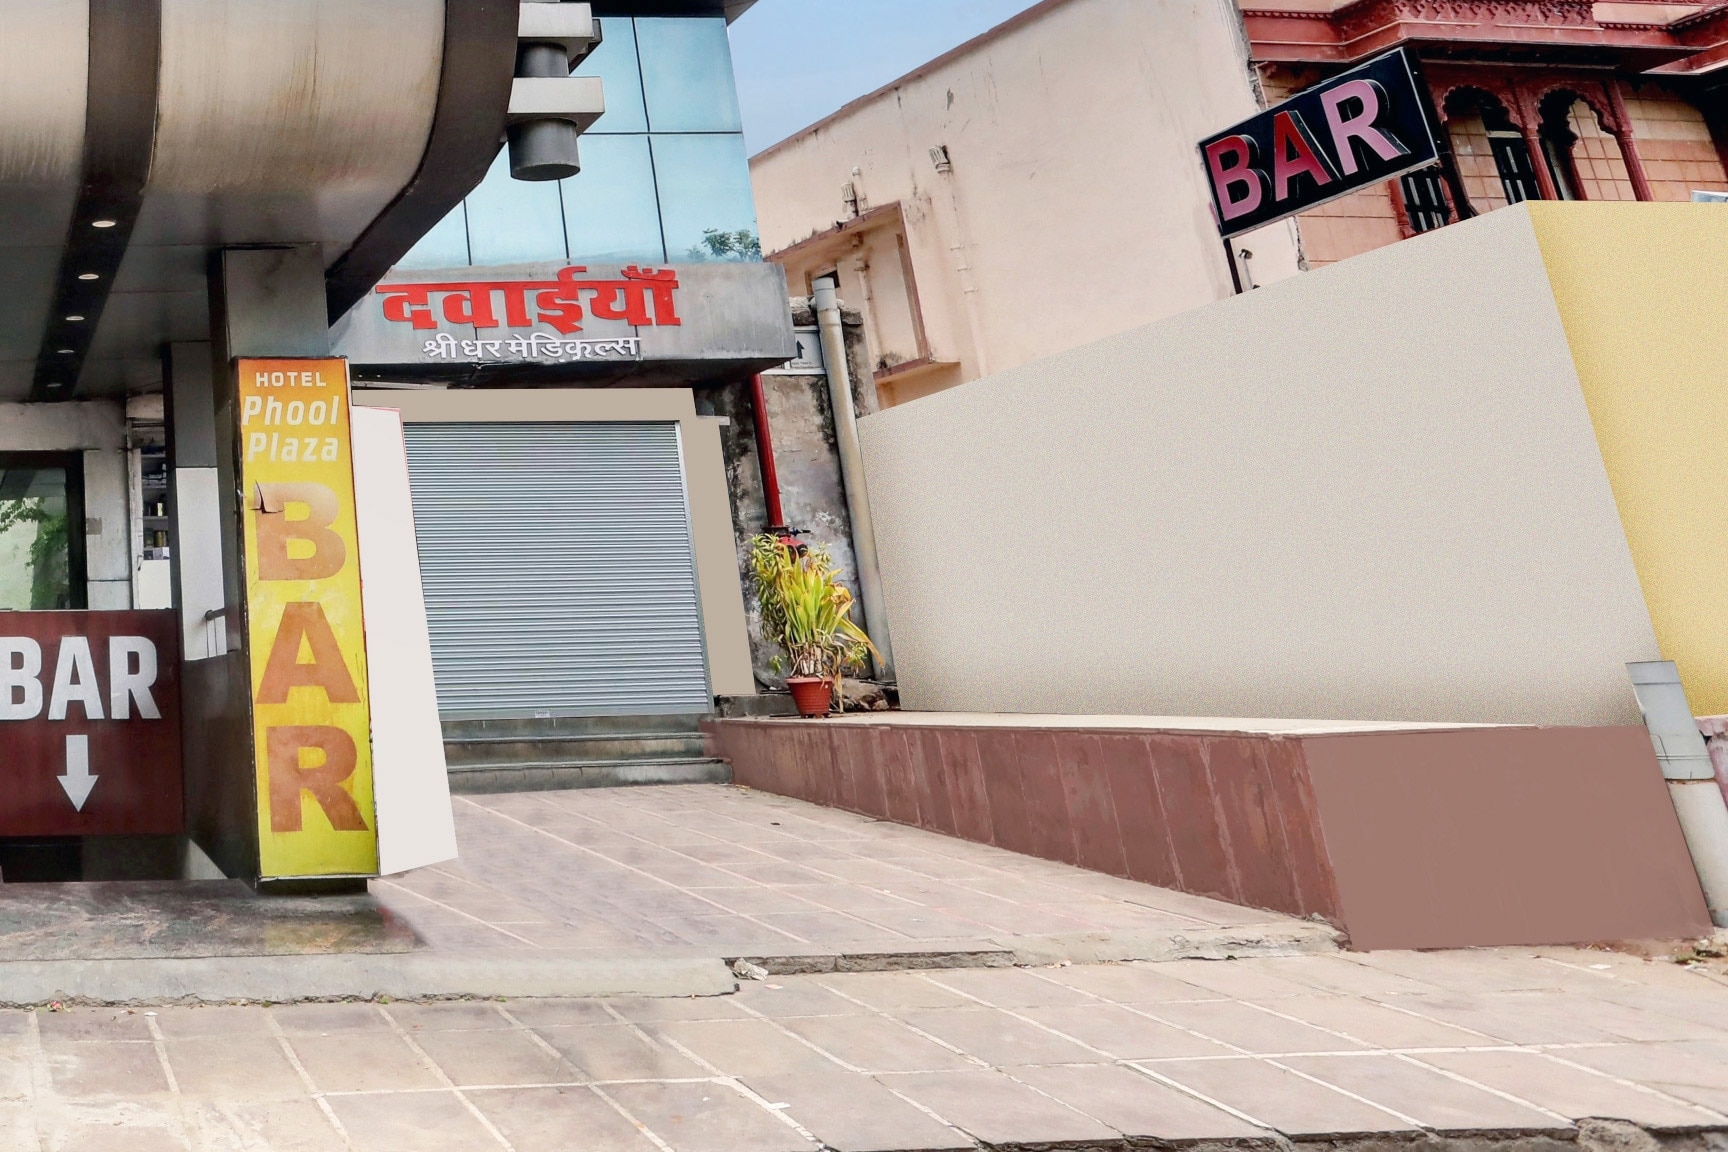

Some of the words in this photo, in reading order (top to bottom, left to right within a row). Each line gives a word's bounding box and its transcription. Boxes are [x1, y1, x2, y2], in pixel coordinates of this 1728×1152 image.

[1205, 78, 1410, 222] BAR
[255, 371, 327, 388] HOTEL
[242, 395, 340, 426] Phool
[247, 432, 339, 463] Plaza
[254, 481, 369, 832] BAR
